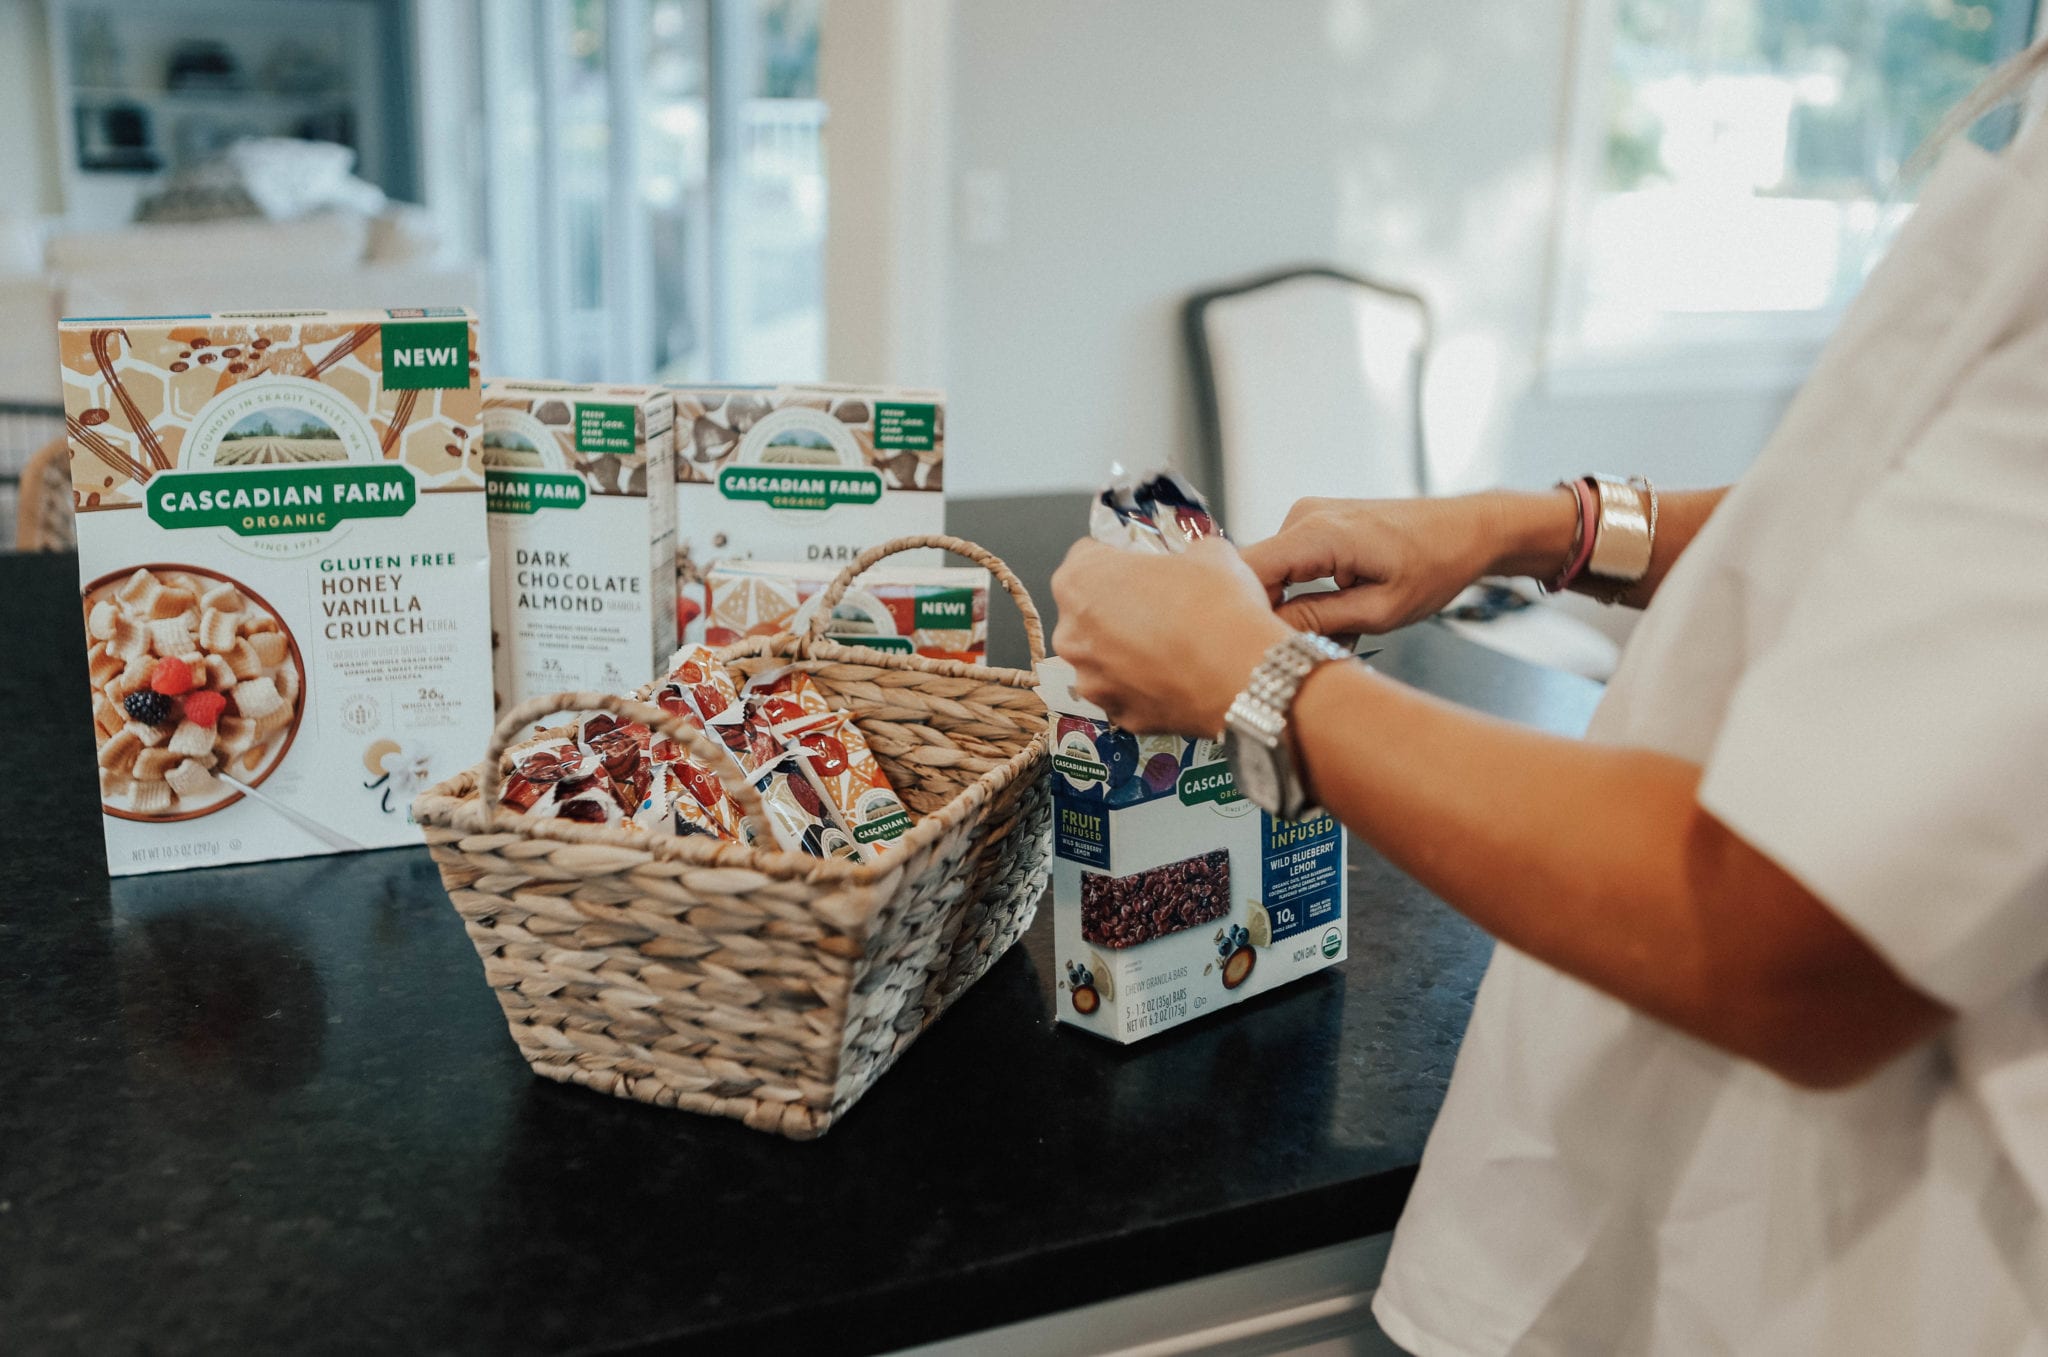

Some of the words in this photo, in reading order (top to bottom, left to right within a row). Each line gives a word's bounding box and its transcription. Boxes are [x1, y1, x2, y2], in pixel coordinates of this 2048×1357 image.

[393, 347, 458, 368] NEW!
[534, 483, 580, 500] FARM
[725, 475, 825, 495] CASCADIAN
[829, 479, 877, 496] FARM
[160, 485, 323, 512] CASCADIAN
[333, 481, 406, 504] FARM
[773, 496, 826, 507] ORGANIC
[242, 512, 327, 529] ORGANIC
[254, 540, 288, 552] SINCE
[320, 555, 401, 572] GLUTEN
[410, 552, 456, 567] FREE
[516, 549, 570, 567] DARK
[321, 573, 402, 595] HONEY
[517, 571, 641, 593] CHOCOLATE
[322, 595, 422, 617] VANILLA
[518, 593, 604, 612] ALMOND
[921, 601, 966, 616] NEW!
[324, 617, 424, 640] CRUNCH
[1055, 759, 1088, 774] CASCADIAN
[1088, 765, 1106, 777] FARM
[858, 818, 903, 839] CASCADIAN
[1062, 809, 1102, 833] FRUIT
[1062, 824, 1102, 841] INFUSED
[1272, 818, 1335, 849] INFUSED
[131, 848, 146, 861] NET
[1062, 837, 1075, 847] WILD
[1074, 840, 1103, 854] BLUEBERRY
[1073, 847, 1091, 857] LEMON
[1270, 856, 1290, 871] WILD
[1291, 841, 1335, 864] BLUEBERRY
[1290, 859, 1317, 877] LEMON
[1276, 908, 1295, 924] 10g
[1125, 980, 1146, 996] CHEWY
[1146, 971, 1172, 990] GRANOLA
[1173, 966, 1188, 981] BARS
[1146, 999, 1156, 1012] OZ
[1156, 992, 1172, 1009] (35g)
[1172, 988, 1187, 1003] BARS
[1126, 1019, 1138, 1033] NET
[1140, 1015, 1148, 1029] WT
[1159, 1008, 1168, 1022] OZ
[1168, 1001, 1188, 1020] (175g)
